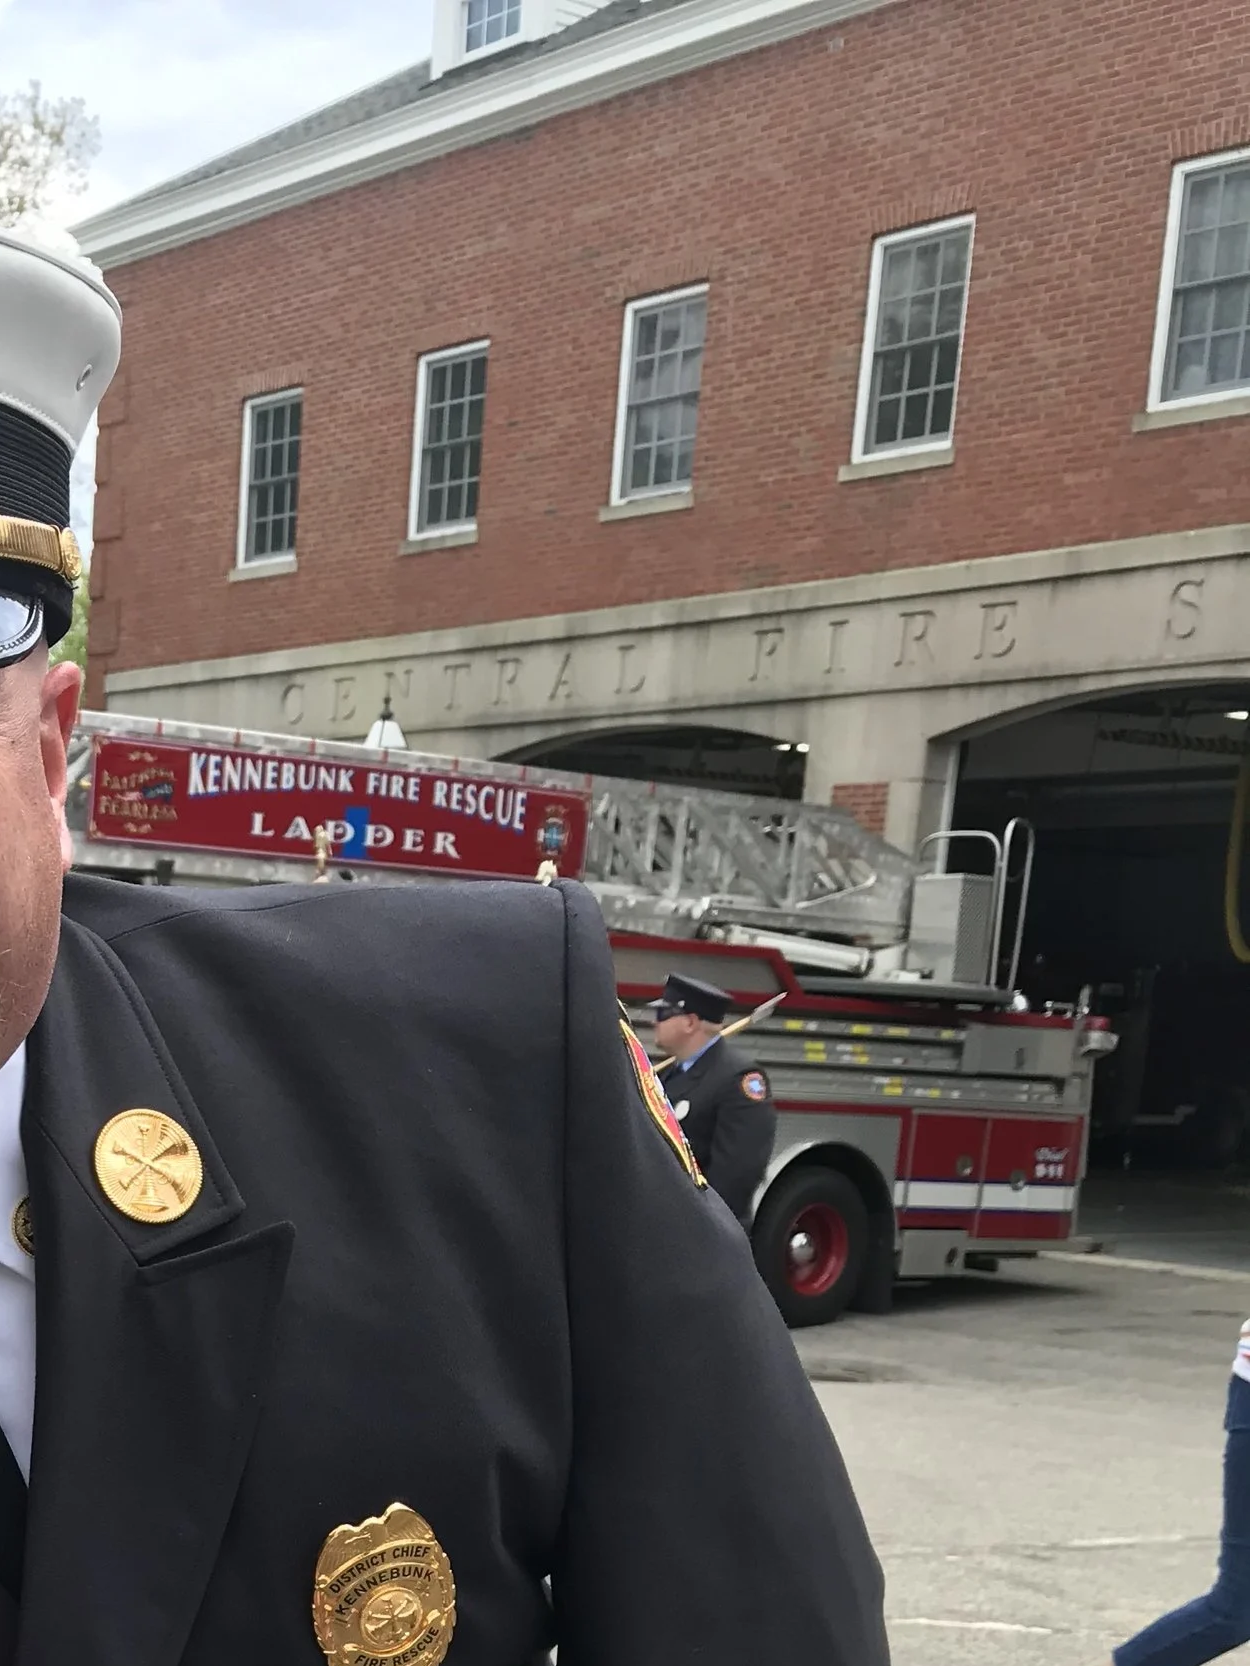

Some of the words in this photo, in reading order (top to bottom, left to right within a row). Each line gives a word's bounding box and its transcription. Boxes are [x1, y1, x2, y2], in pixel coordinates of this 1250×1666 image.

[280, 645, 646, 725] CENTRAL
[748, 600, 1018, 682] FIRE
[187, 751, 354, 798] KENNEBUNK
[366, 771, 421, 802] FIRE
[433, 779, 528, 832] RESCUE
[251, 811, 461, 860] LADDER
[328, 1551, 388, 1594] DISTRICT
[392, 1545, 432, 1559] CHIEF
[335, 1566, 435, 1616] KENNEBUNK
